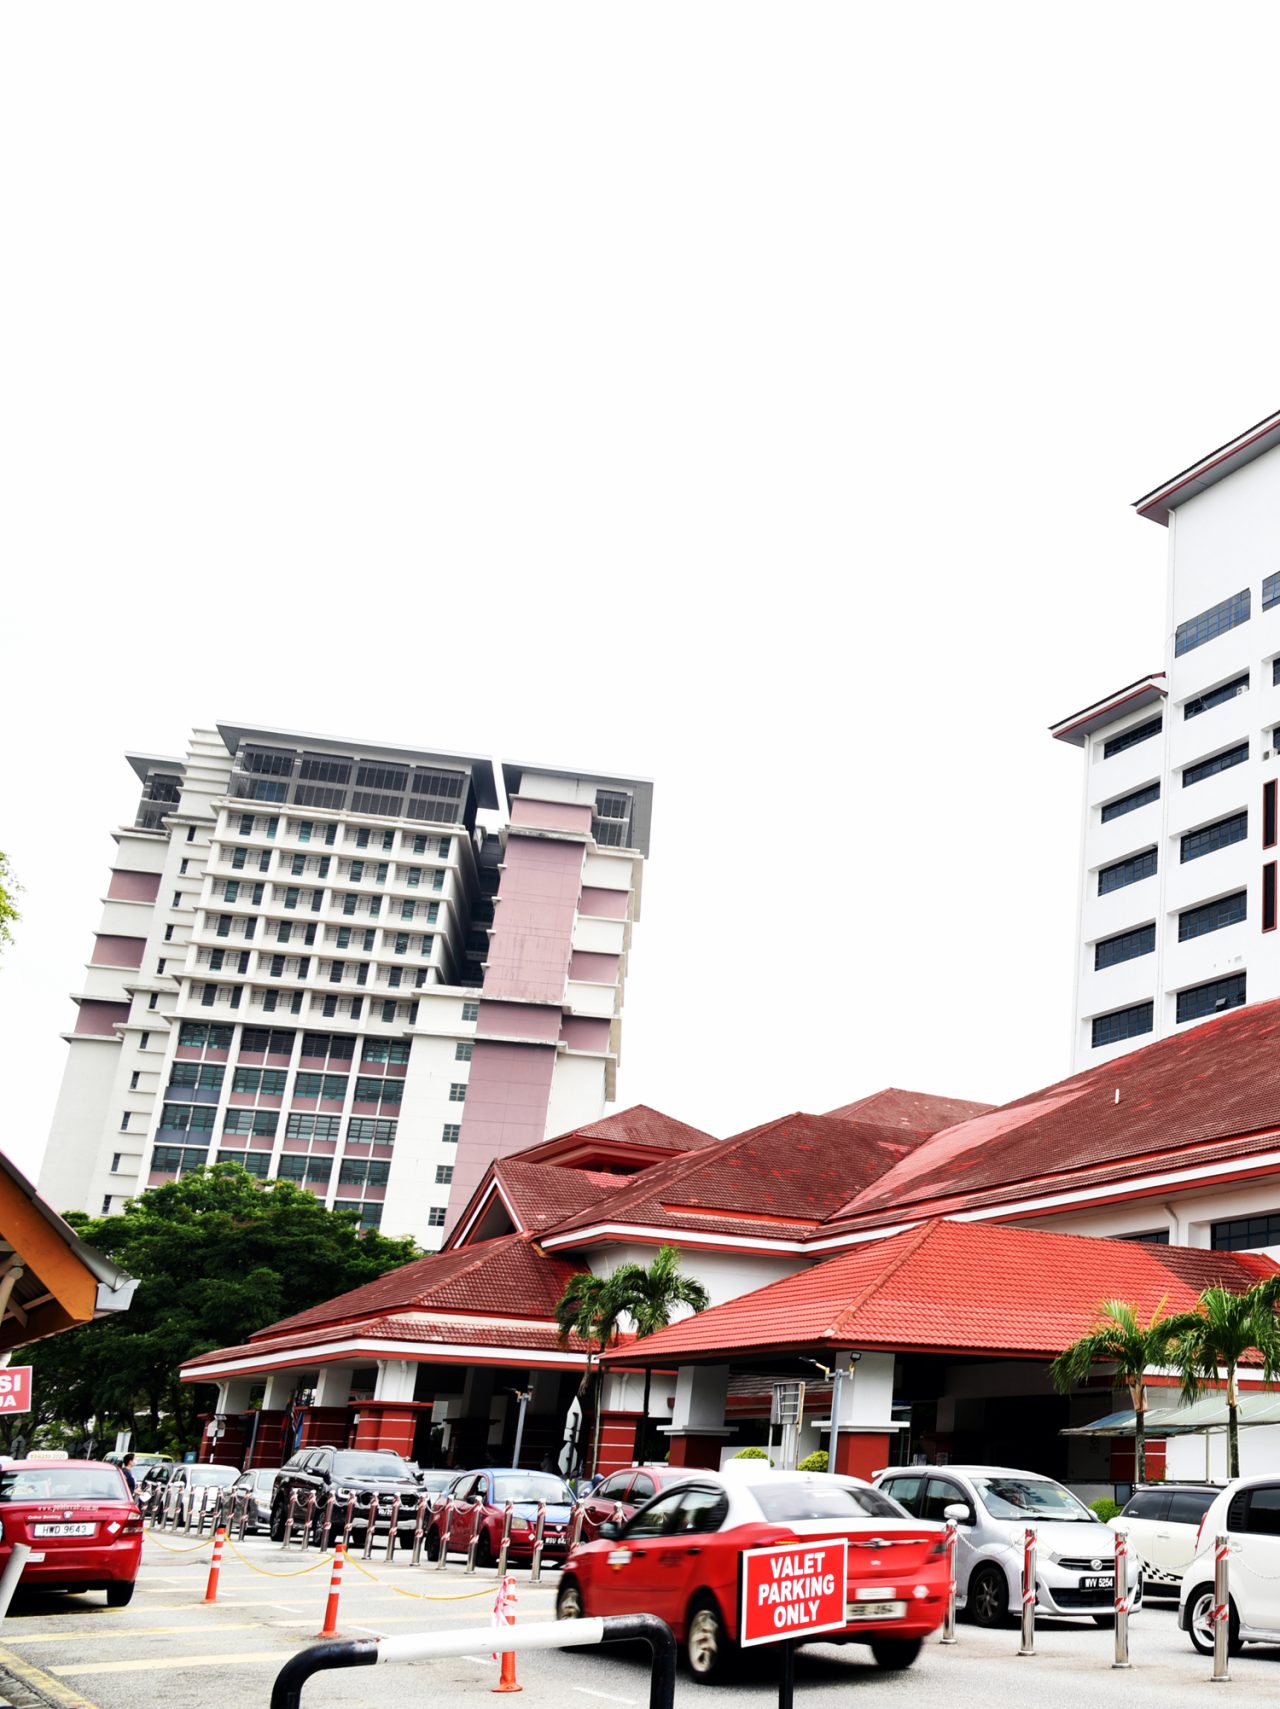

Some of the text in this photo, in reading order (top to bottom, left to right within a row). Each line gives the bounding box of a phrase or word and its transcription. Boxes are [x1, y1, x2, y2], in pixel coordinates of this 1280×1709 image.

[42, 1525, 87, 1534] HWD 9643
[770, 1552, 826, 1579] VALET
[758, 1574, 835, 1606] PARKING
[1098, 1578, 1113, 1587] 5254
[773, 1600, 820, 1628] ONLY
